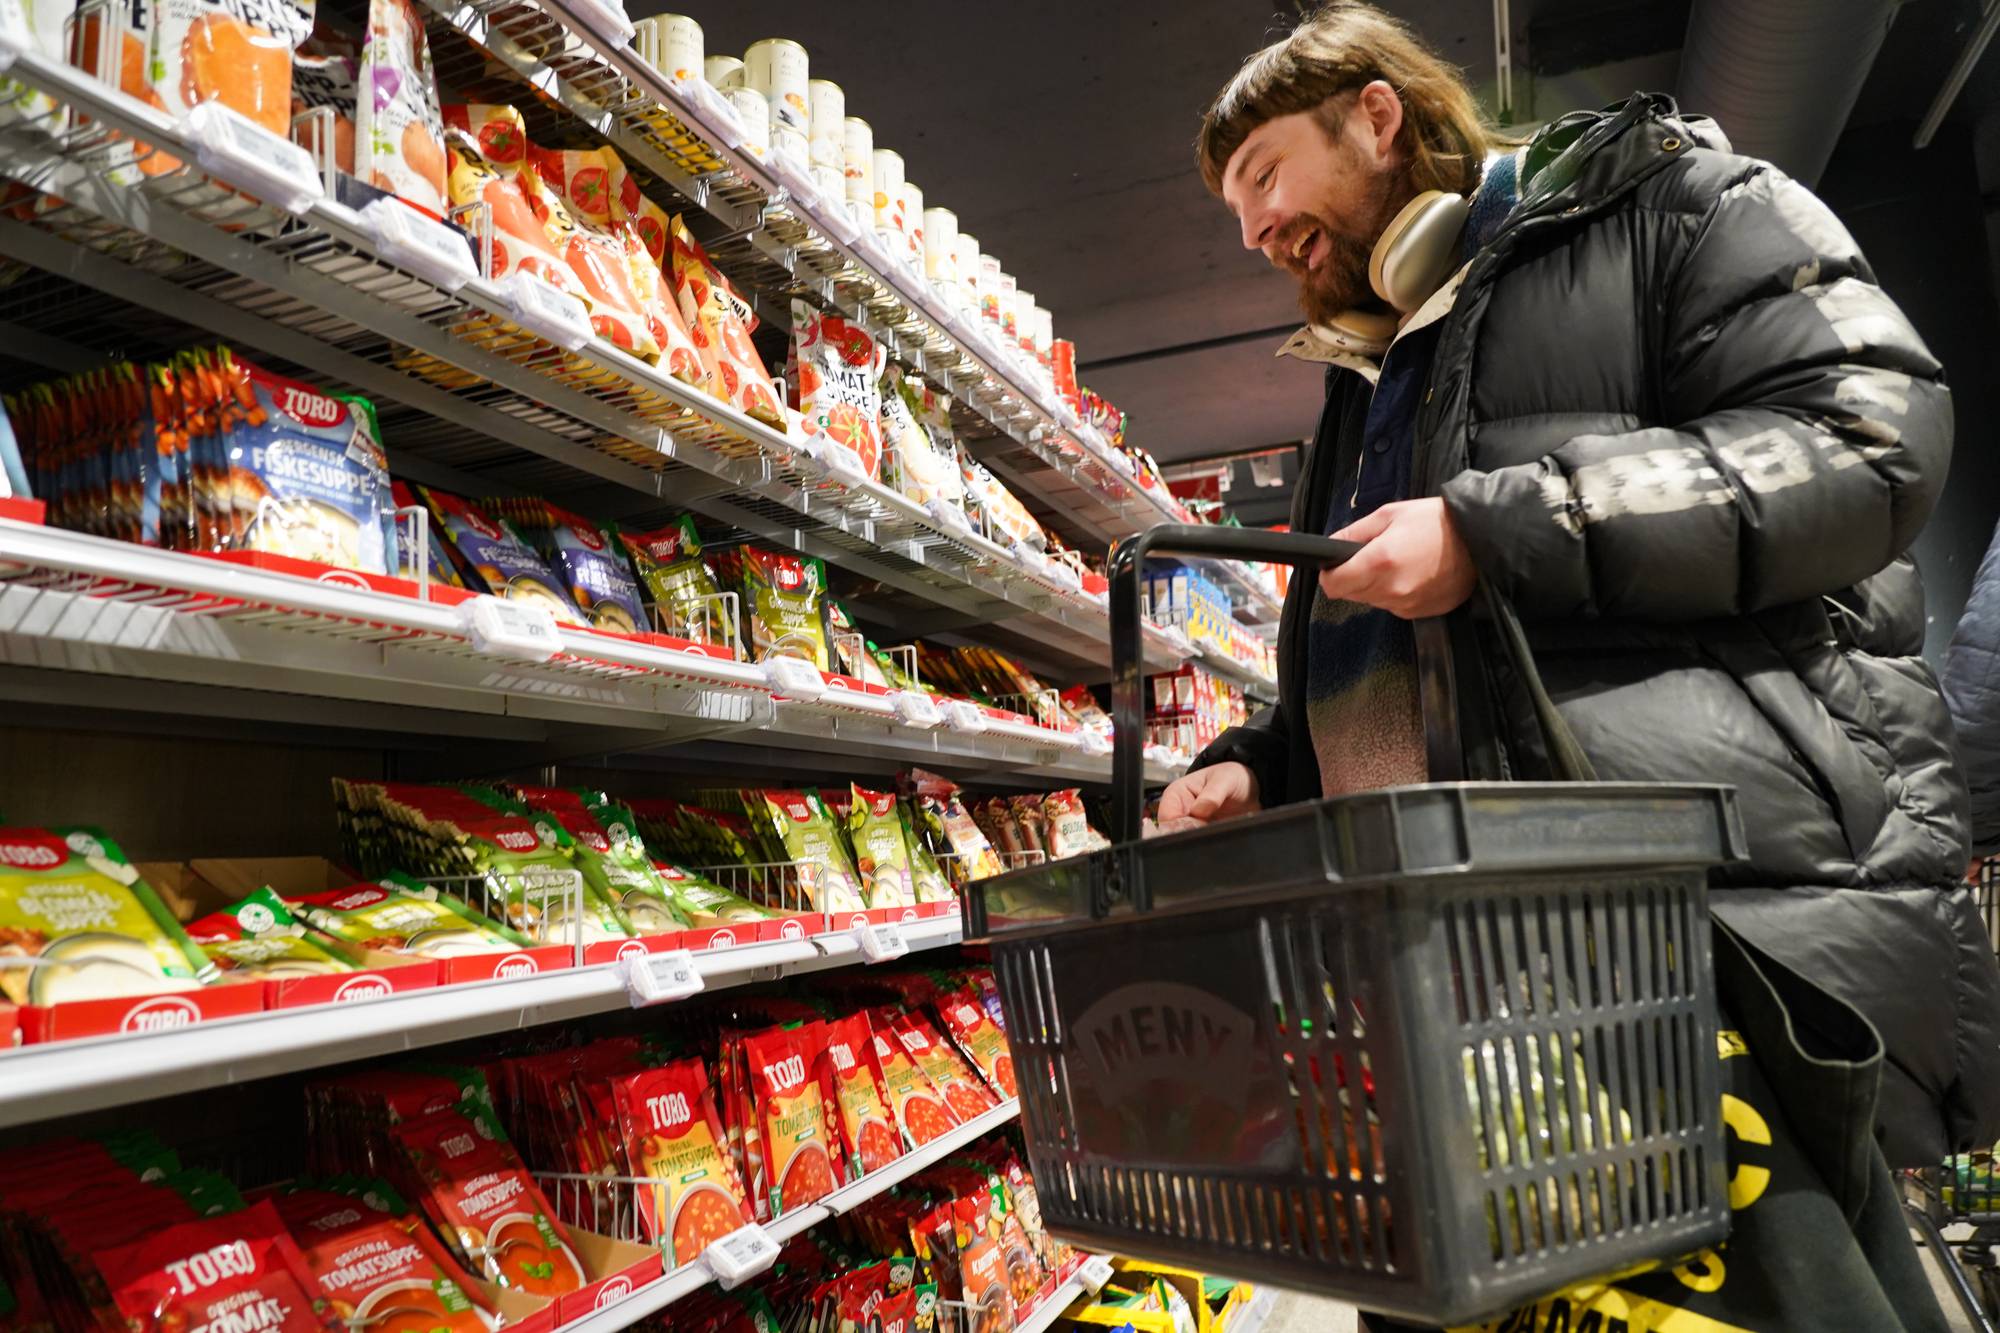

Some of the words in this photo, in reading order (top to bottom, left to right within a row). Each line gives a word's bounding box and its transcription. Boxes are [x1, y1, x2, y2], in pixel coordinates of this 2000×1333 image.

[284, 387, 338, 422] TORO
[252, 447, 377, 497] FISKESUPPE
[496, 831, 535, 849] TORO
[501, 964, 532, 979] TORO
[343, 985, 386, 1002] TORO
[134, 1008, 190, 1032] TORO
[1094, 1004, 1233, 1075] MENY
[763, 1054, 805, 1093] TORO
[646, 1091, 691, 1130] TORO
[440, 1133, 476, 1159] TORO
[652, 1145, 718, 1179] TOMATSUPPE
[457, 1176, 525, 1217] TOMATSUPPE
[164, 1239, 256, 1296] TORO
[319, 1244, 424, 1292] TOMATSUPPE
[335, 1240, 392, 1268] ORIGINAL
[207, 1289, 264, 1319] ORIGINAL
[601, 1282, 627, 1307] TORO
